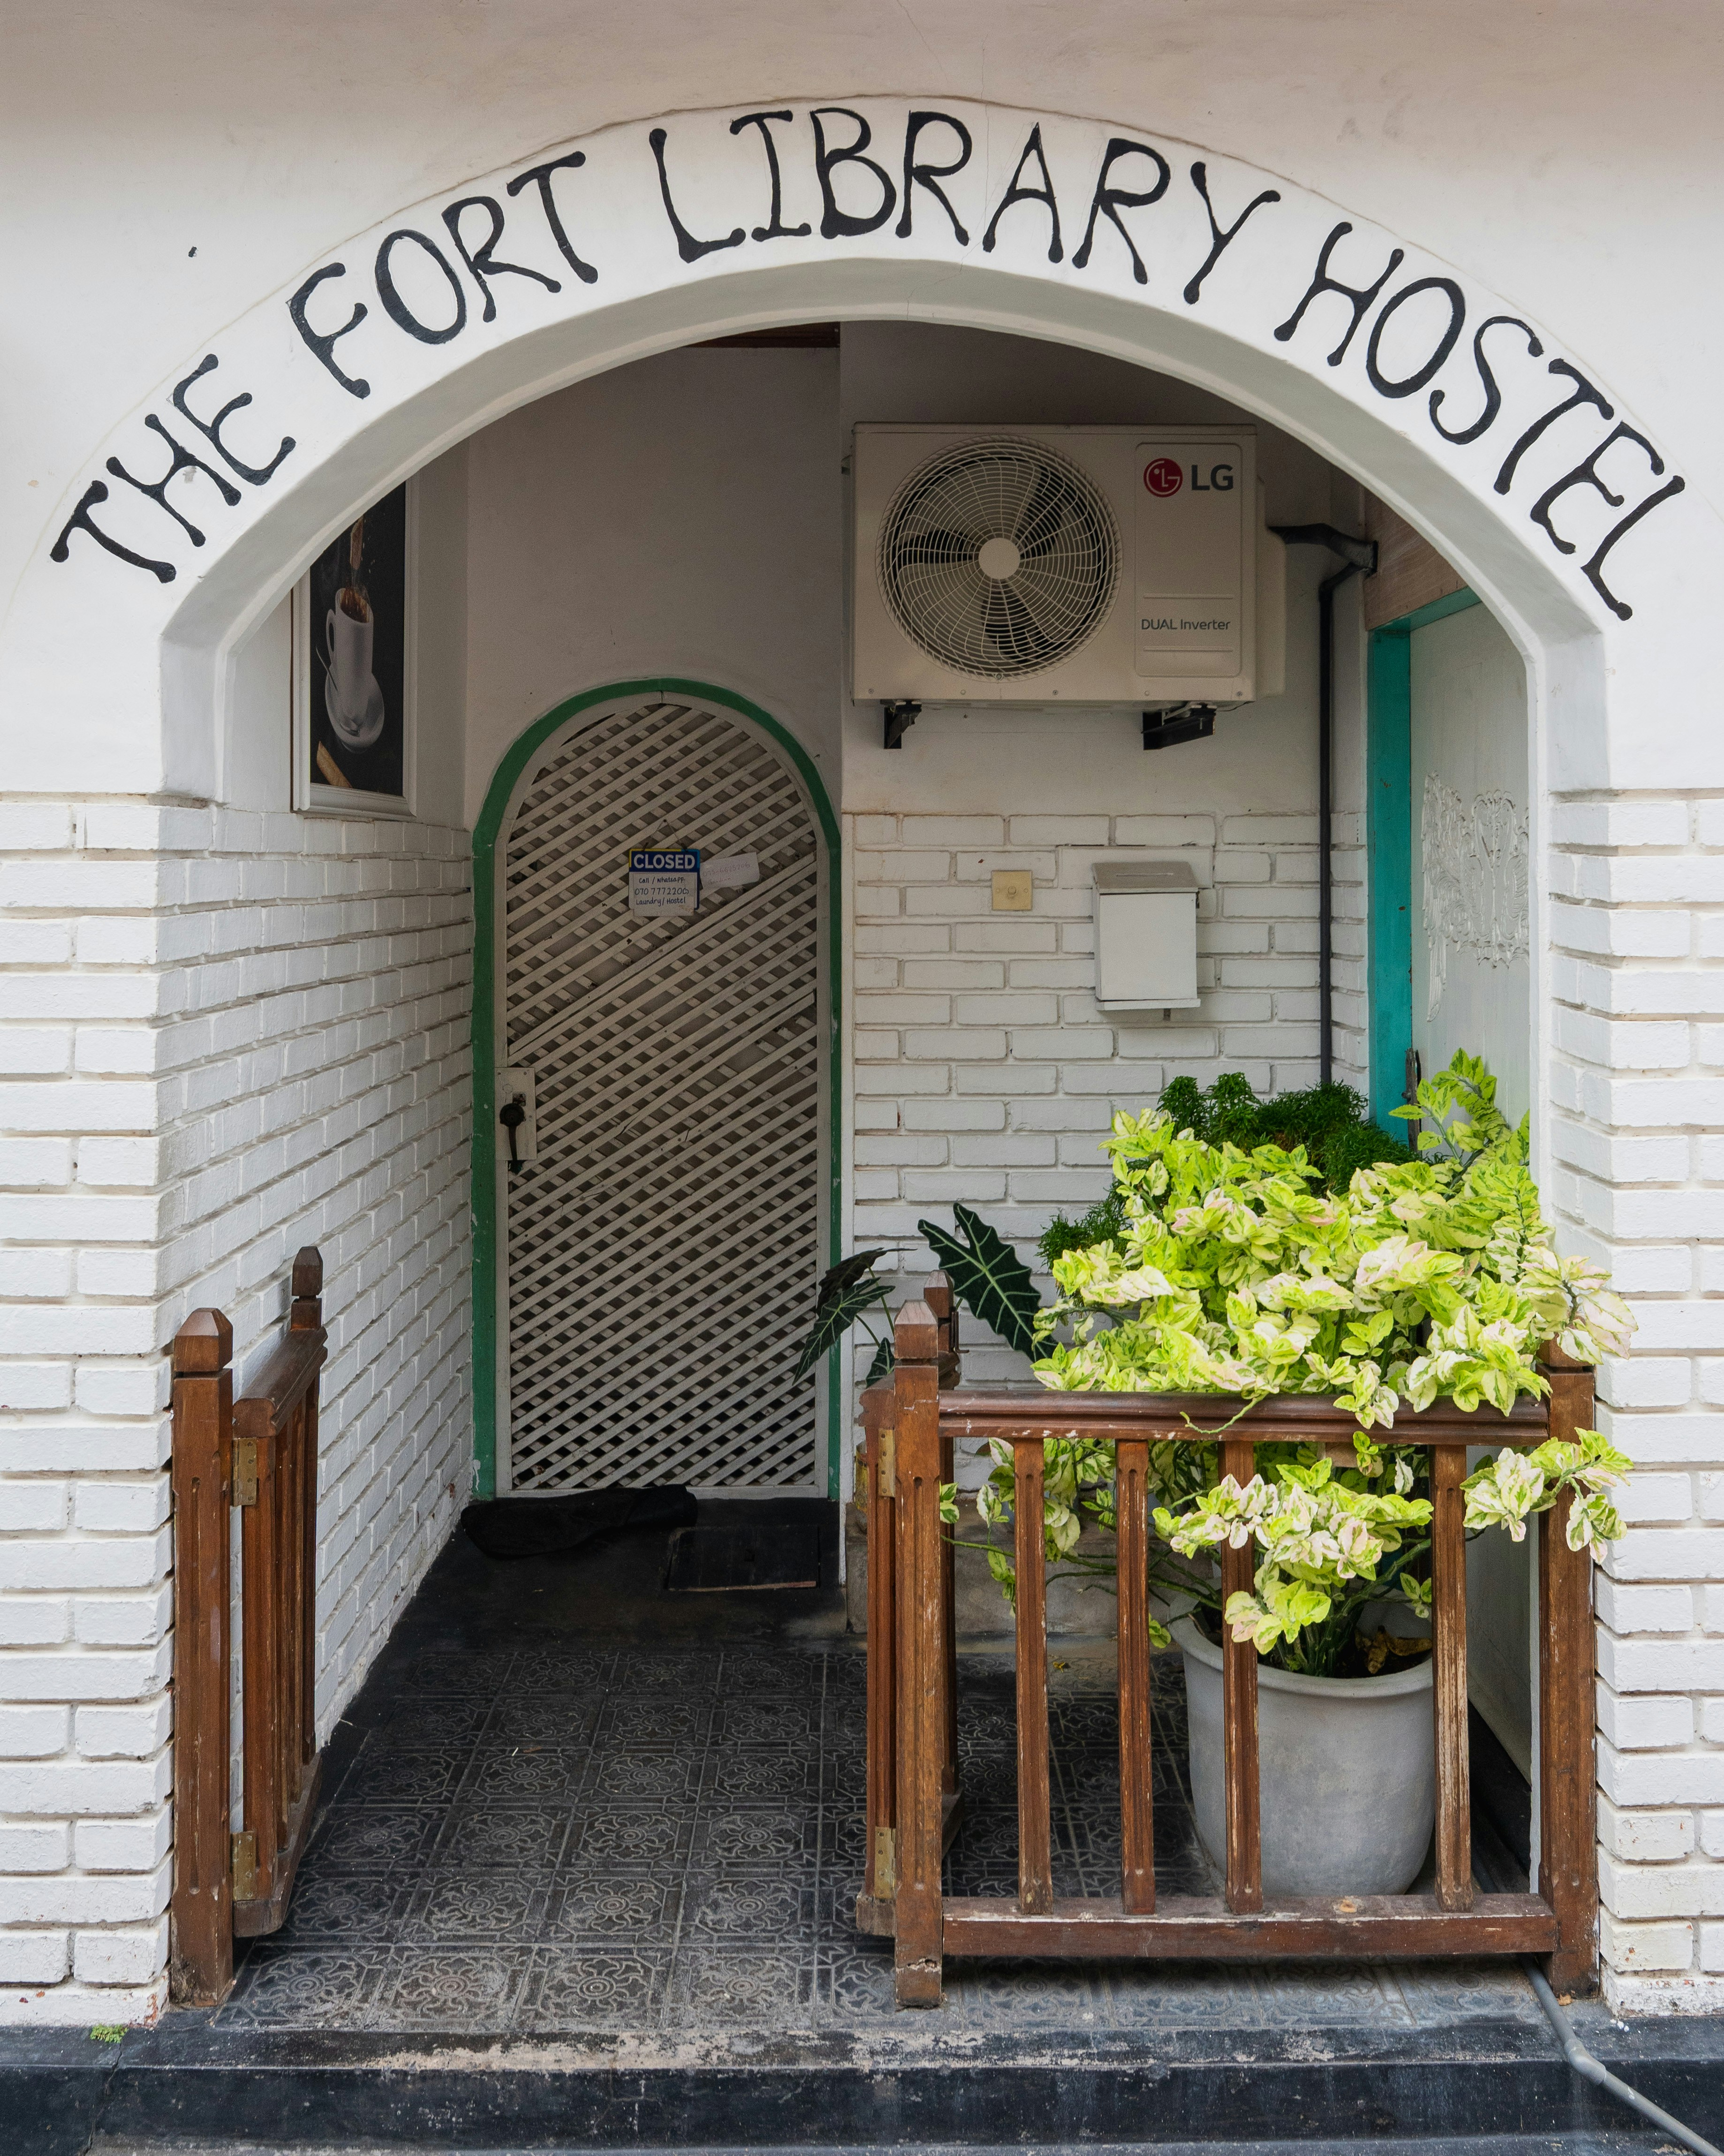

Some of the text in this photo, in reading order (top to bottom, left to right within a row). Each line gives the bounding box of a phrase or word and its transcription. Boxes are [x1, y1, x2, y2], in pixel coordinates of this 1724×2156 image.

[50, 107, 1685, 621] THE FORT LIBRARY HOSTEL
[1191, 464, 1234, 491] LG
[1142, 619, 1231, 630] DUAL Inverter
[634, 854, 695, 869] CLOSED
